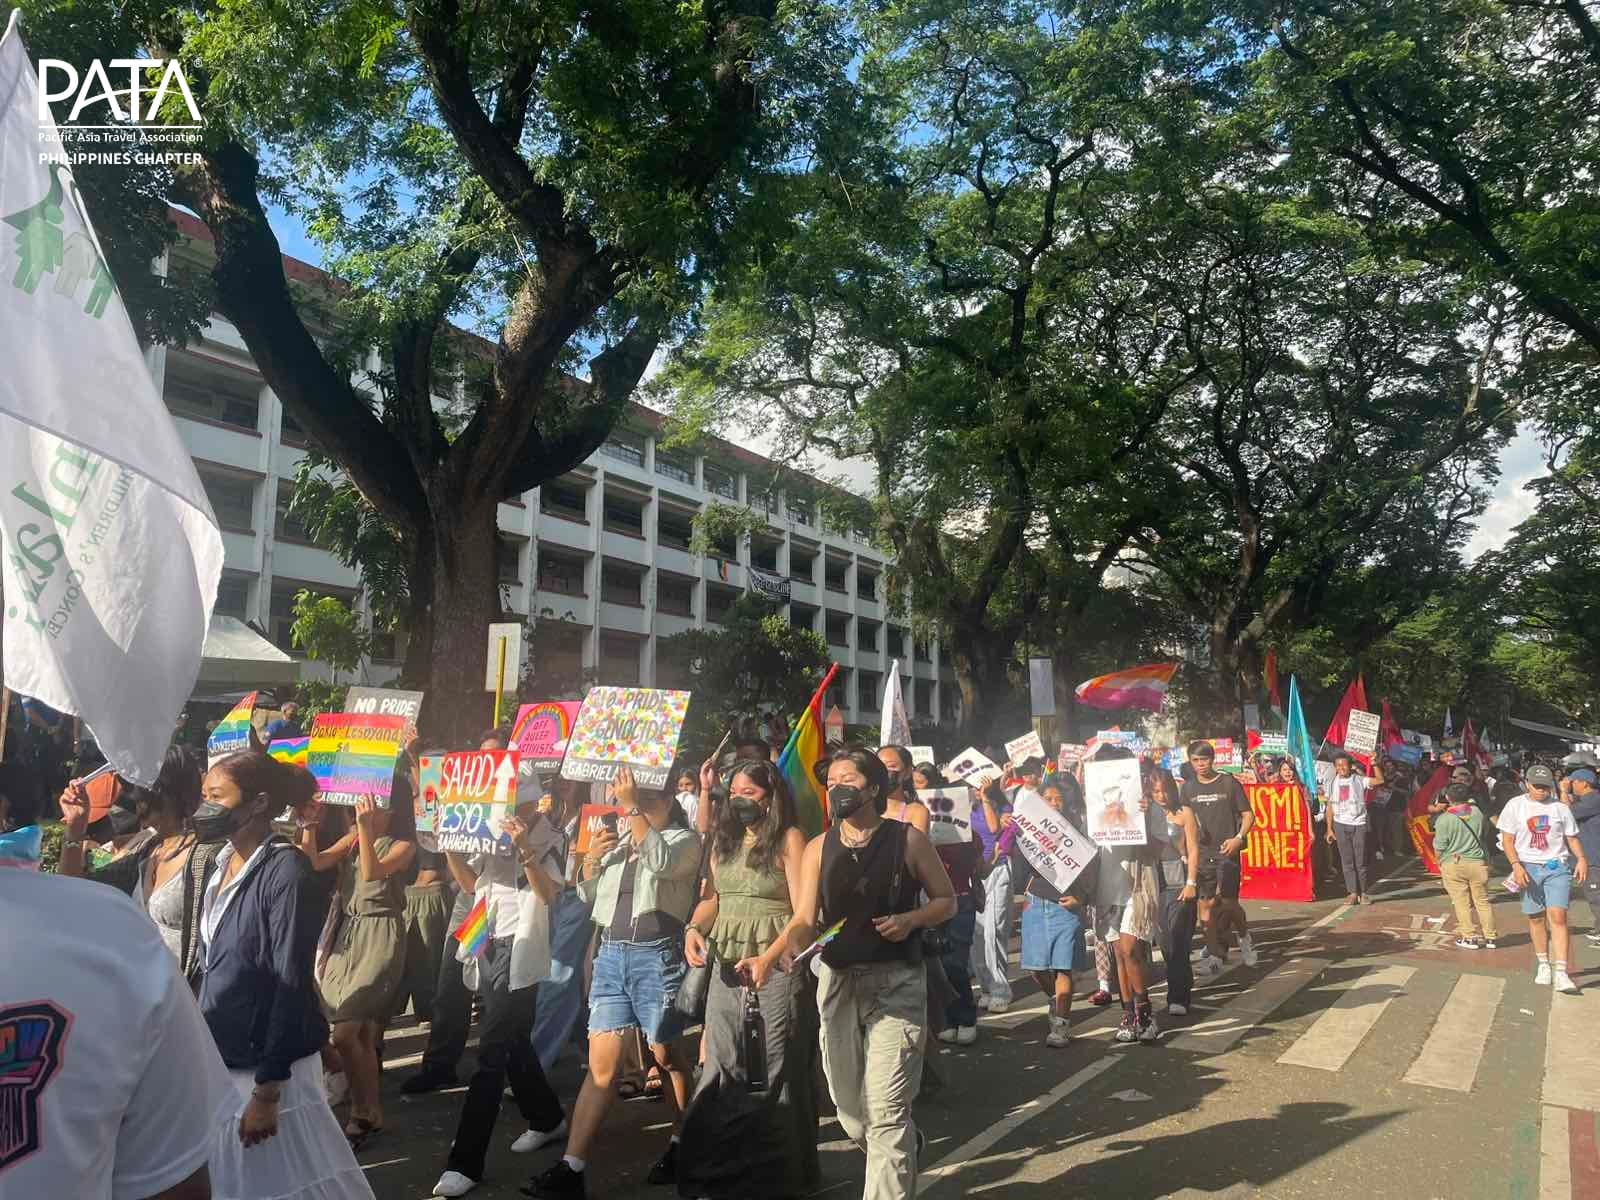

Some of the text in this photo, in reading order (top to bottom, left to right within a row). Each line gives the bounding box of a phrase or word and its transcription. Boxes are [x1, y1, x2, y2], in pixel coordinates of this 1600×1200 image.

[354, 699, 416, 715] NO PRIDE
[1013, 814, 1081, 871] IMPERIALIST
[1040, 818, 1074, 848] NO TO
[1021, 837, 1056, 869] WARS!
